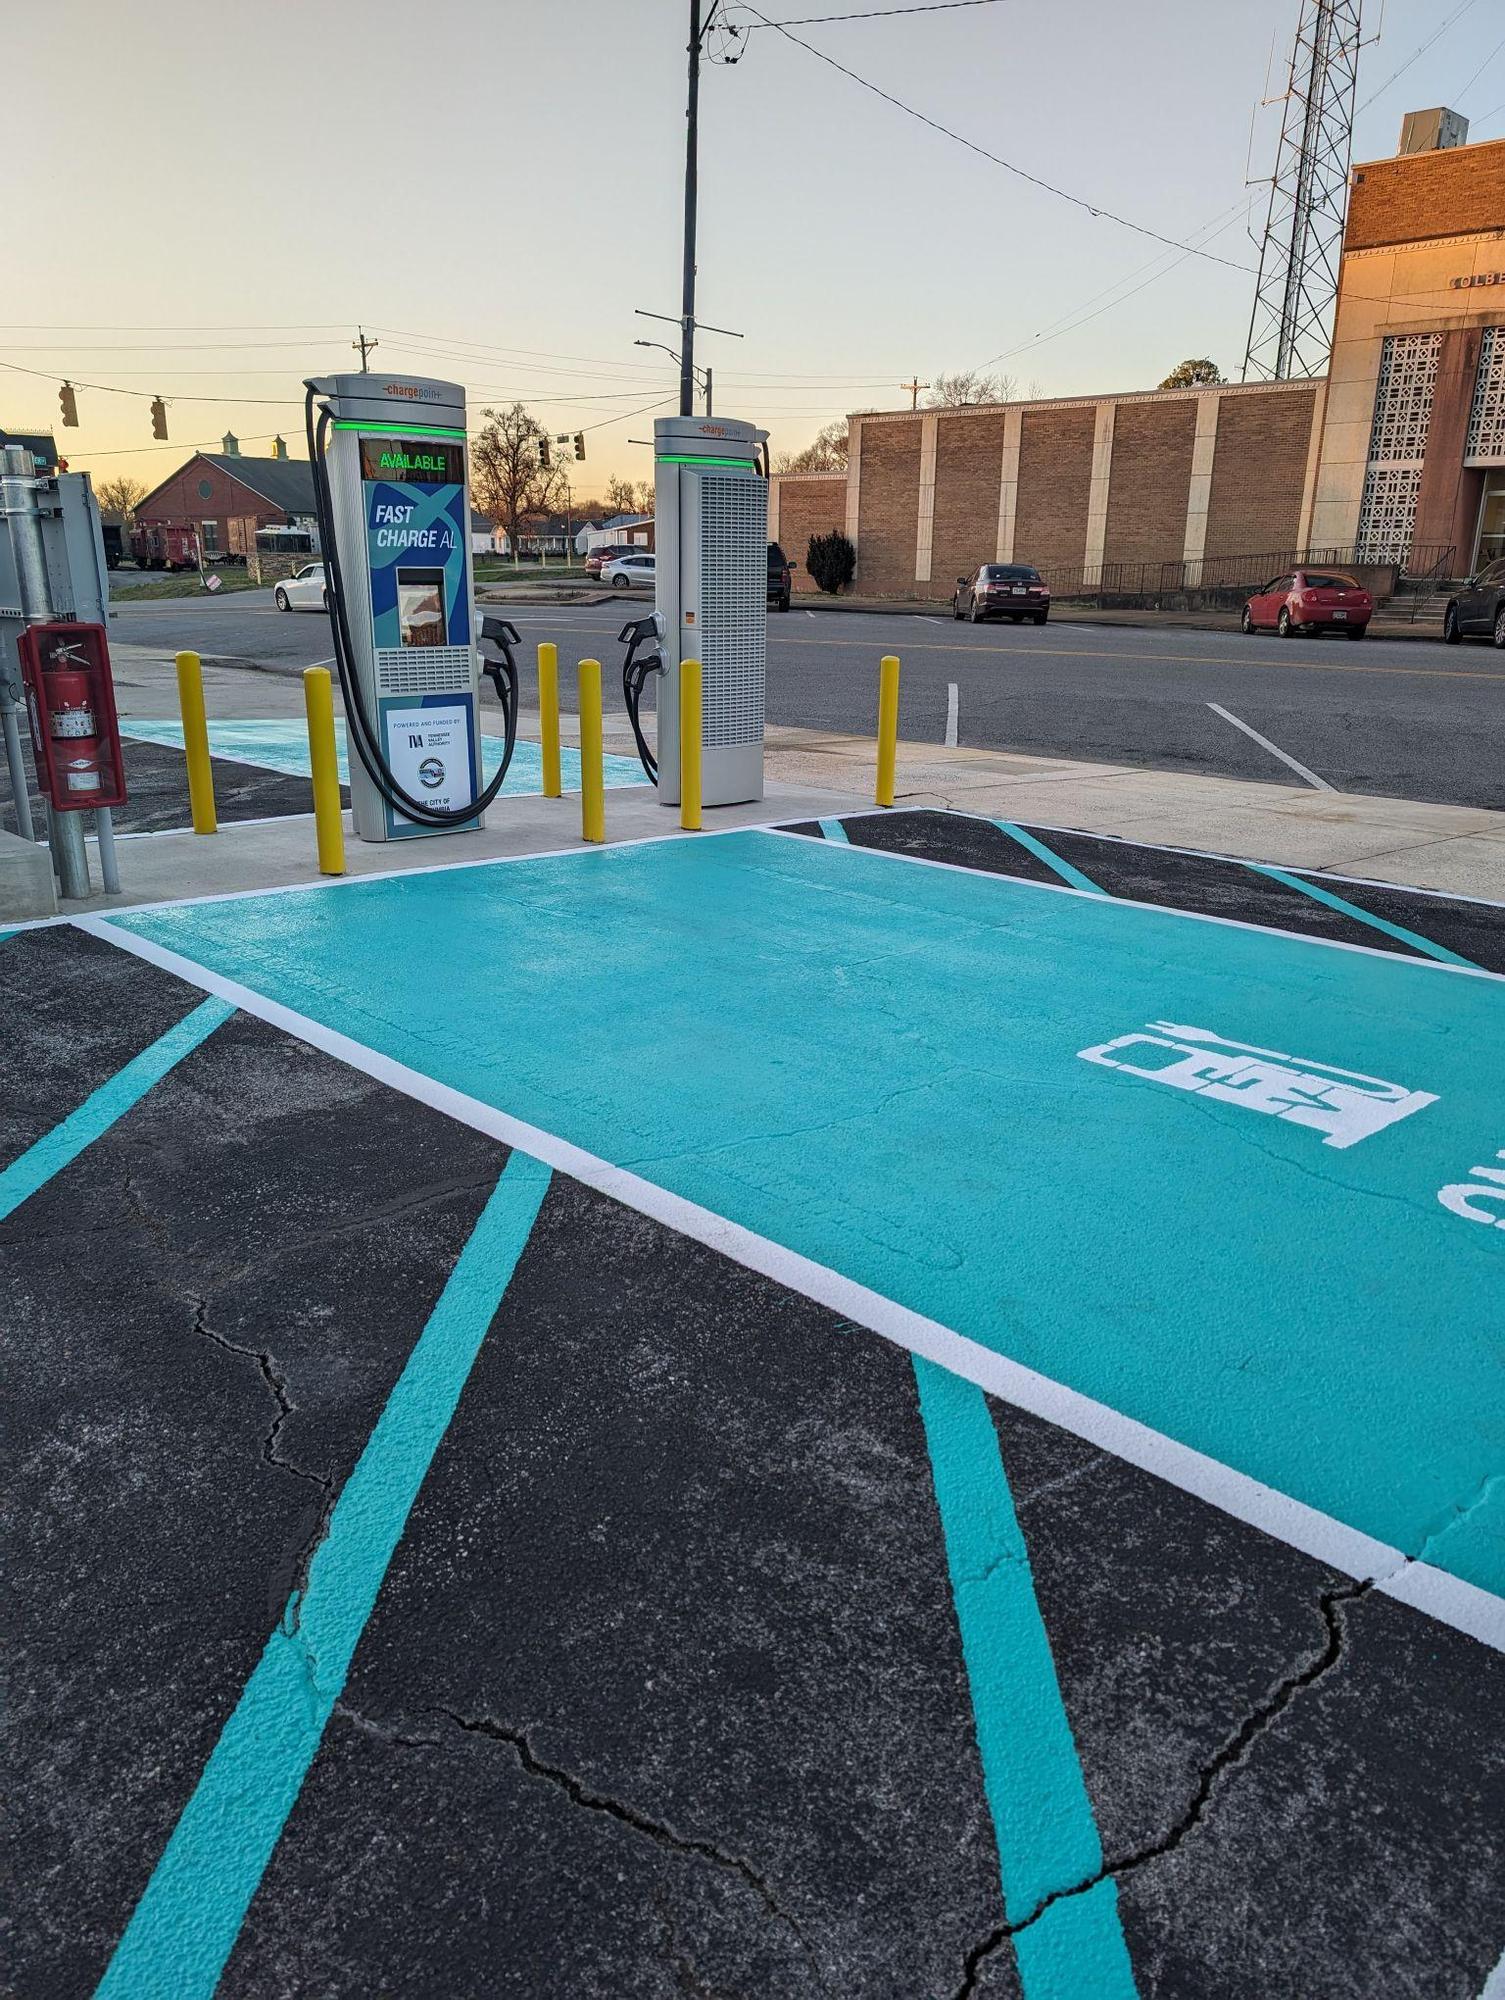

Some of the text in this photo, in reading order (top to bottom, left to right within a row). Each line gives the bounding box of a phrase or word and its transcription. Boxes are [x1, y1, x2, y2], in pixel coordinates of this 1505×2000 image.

[380, 453, 446, 471] AVAILABLE
[375, 504, 414, 524] FAST
[376, 529, 457, 549] CHARGE AL
[409, 735, 423, 749] TVA
